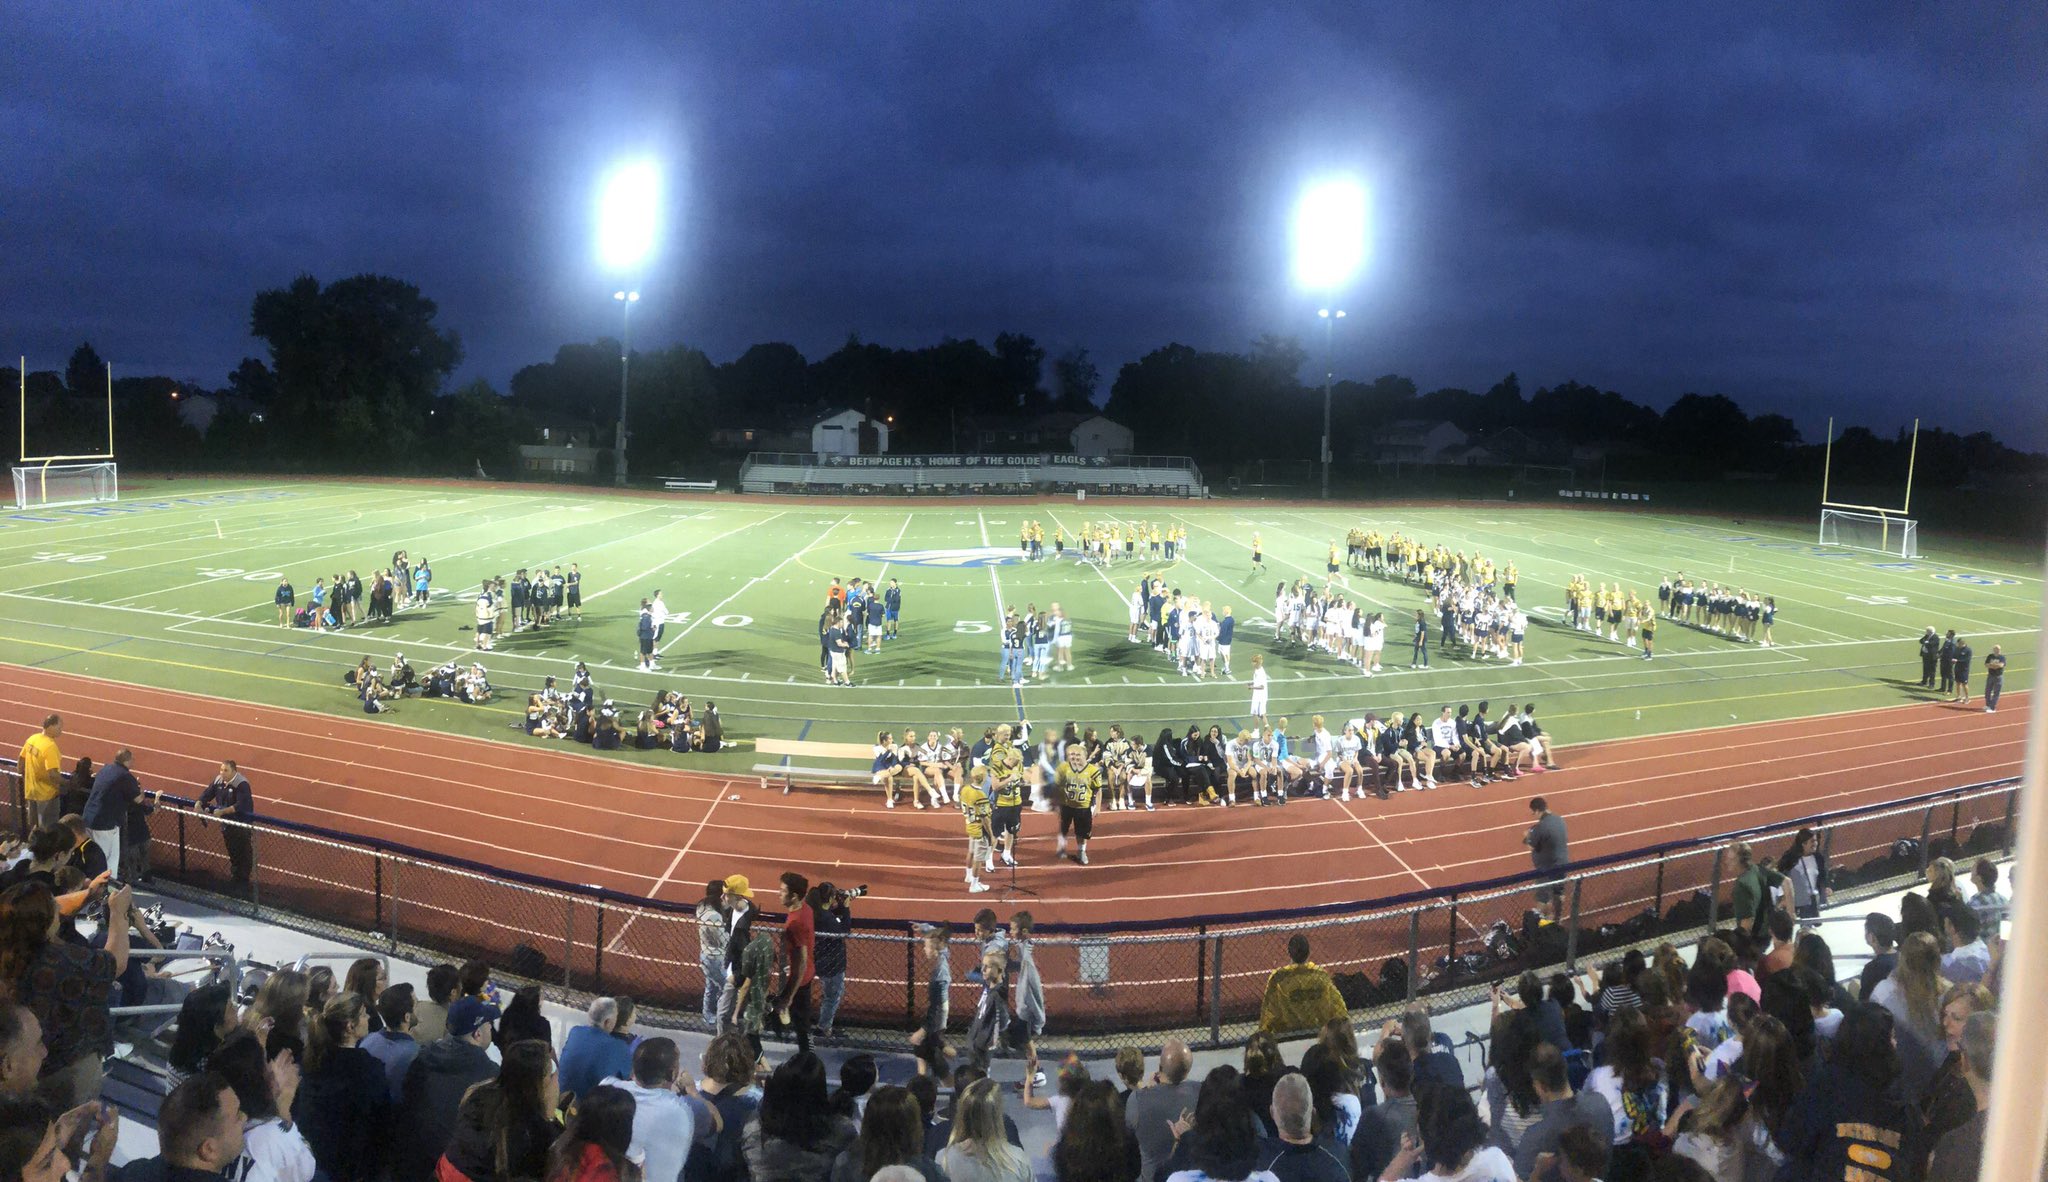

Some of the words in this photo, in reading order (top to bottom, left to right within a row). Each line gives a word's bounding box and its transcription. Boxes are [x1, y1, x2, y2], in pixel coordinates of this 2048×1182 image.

[904, 457, 925, 466] H.S.
[929, 457, 961, 466] HOME
[965, 456, 982, 465] OF
[984, 456, 1004, 465] THE
[1066, 783, 1087, 802] 52
